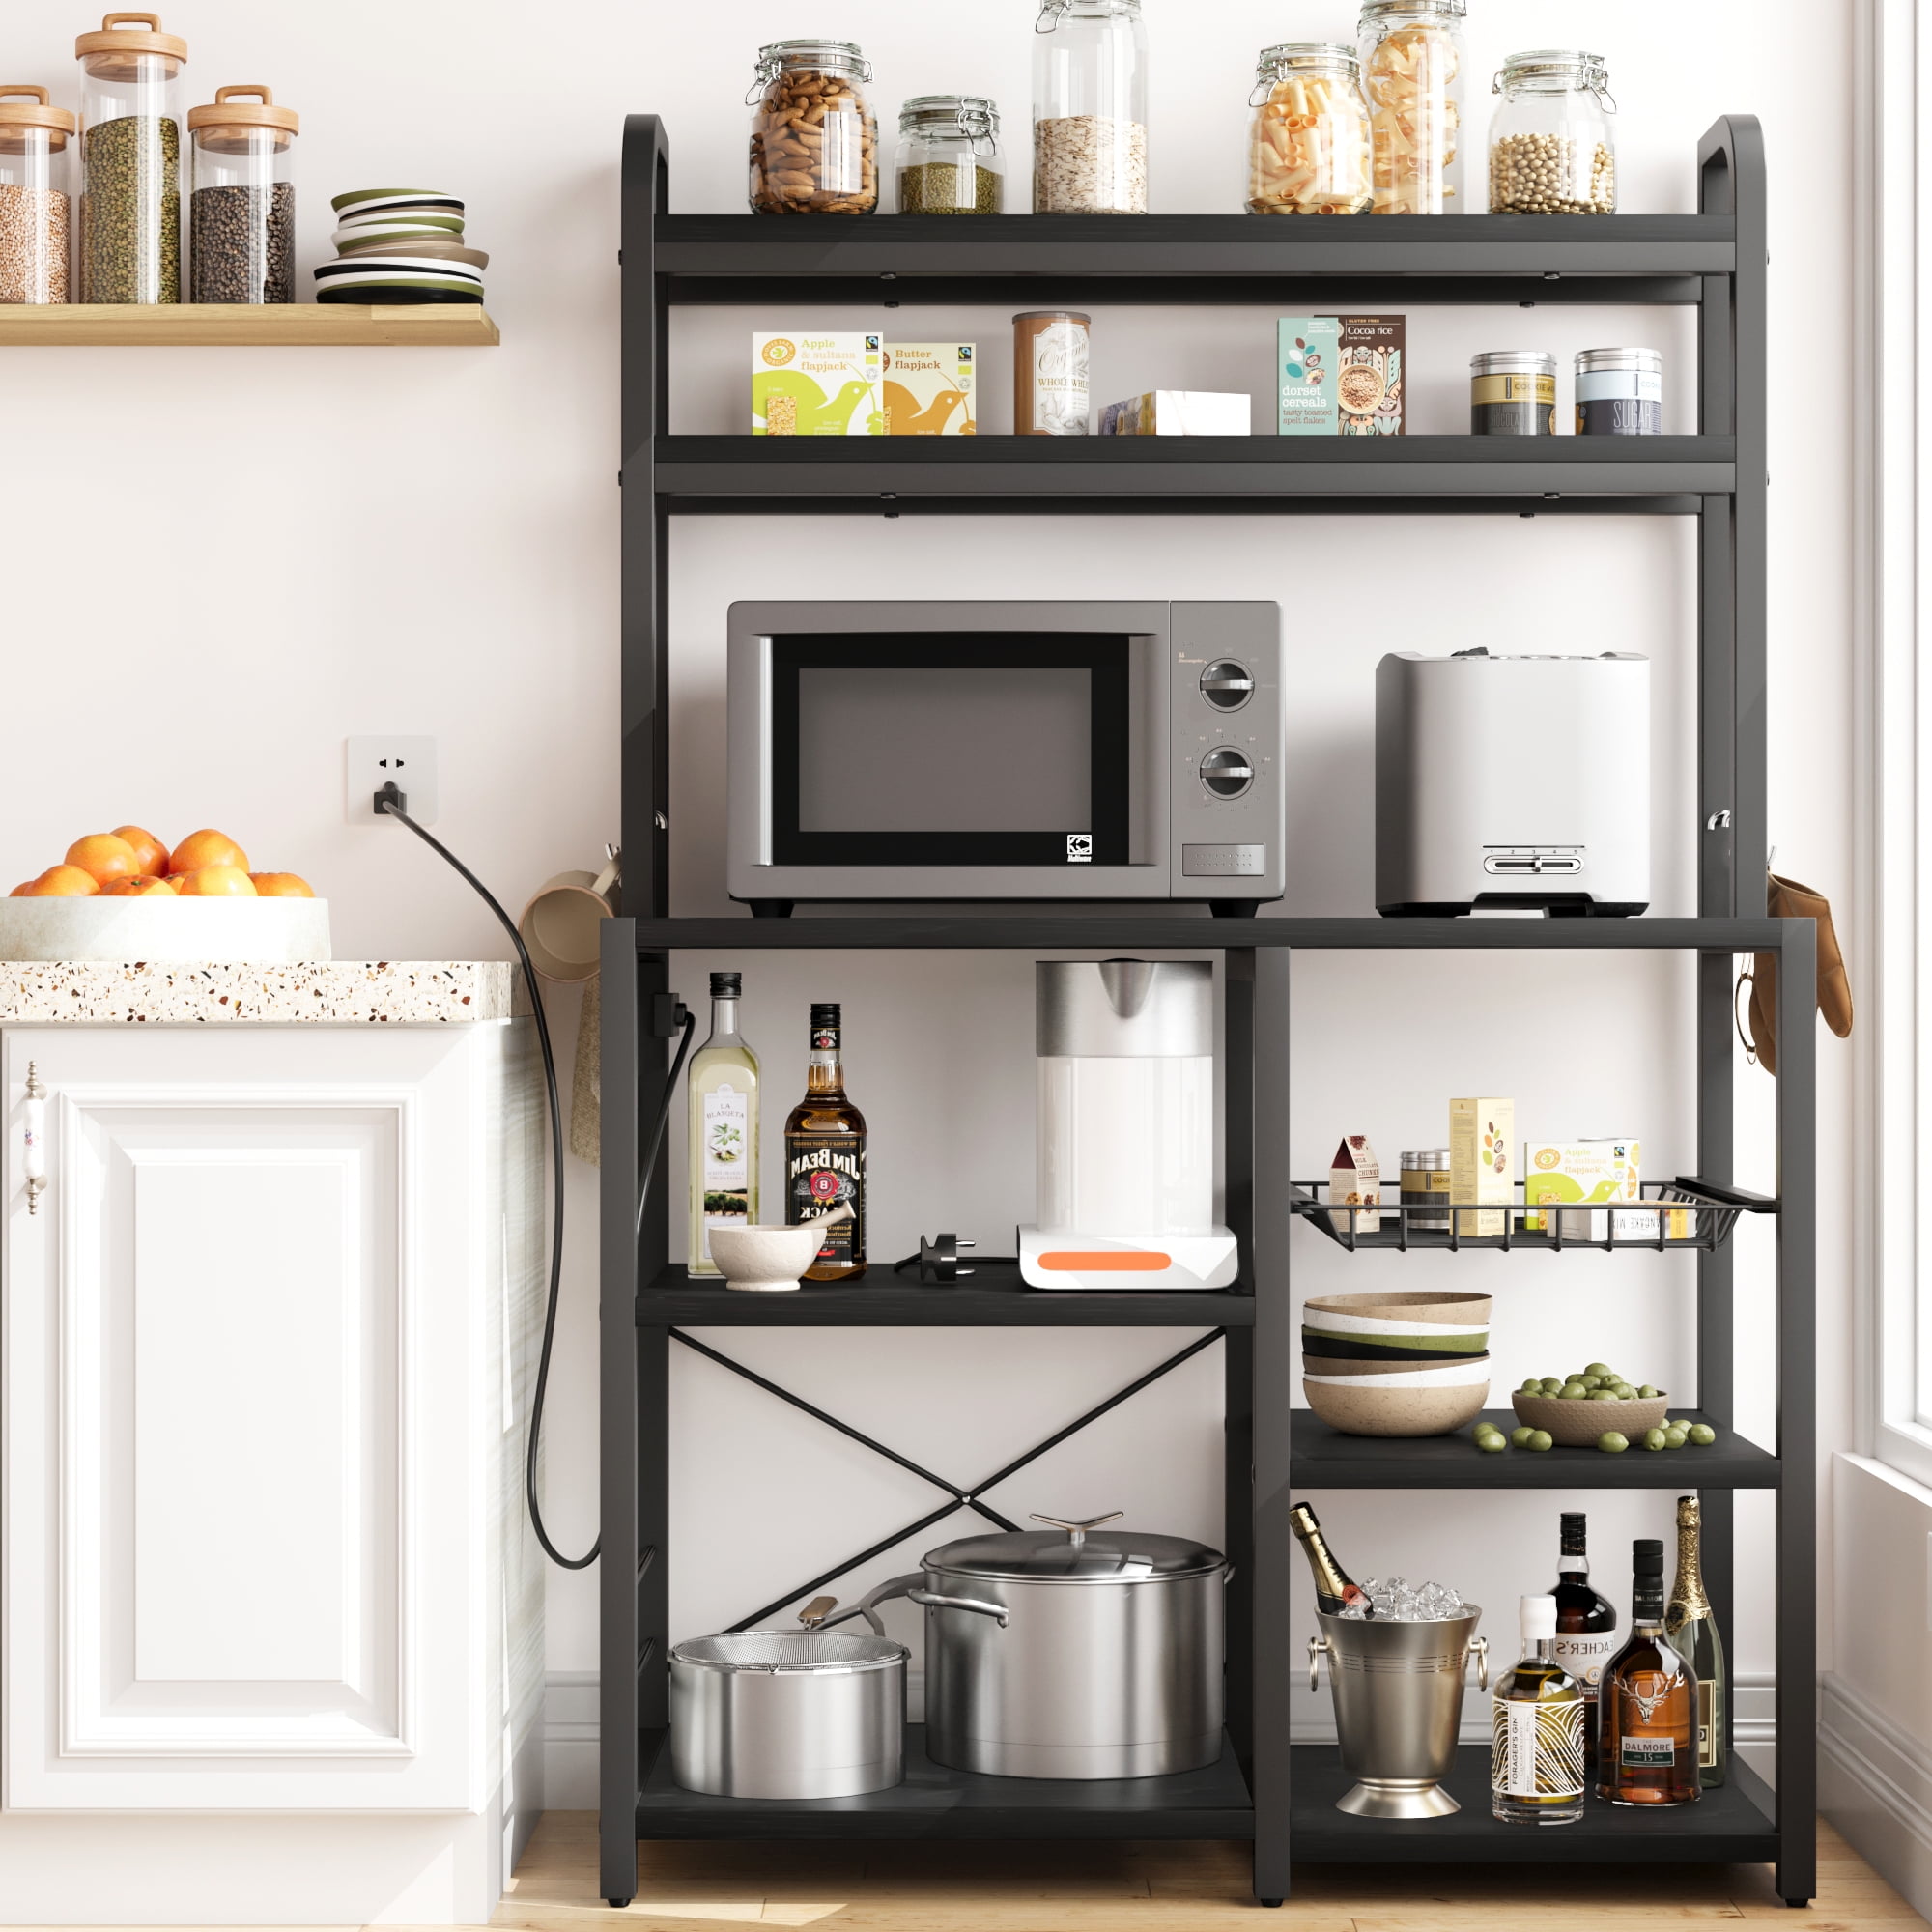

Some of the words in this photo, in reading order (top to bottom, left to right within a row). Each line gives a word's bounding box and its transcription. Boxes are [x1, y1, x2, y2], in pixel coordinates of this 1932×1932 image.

[1347, 326, 1376, 335] Cocoa
[1377, 325, 1394, 335] rice
[801, 339, 836, 350] Apple
[812, 351, 857, 359] sultana
[895, 349, 932, 358] Butter
[801, 361, 848, 373] flapjack
[895, 360, 941, 371] flapjack
[1038, 378, 1067, 387] WHOLE
[1282, 385, 1322, 396] dorset
[1282, 396, 1327, 407] cereals
[1613, 401, 1651, 429] SUGAR
[1565, 1148, 1591, 1156] Apple
[1565, 1166, 1601, 1175] flapjack
[1625, 1742, 1671, 1752] DALMORE
[1643, 1752, 1653, 1762] 15
